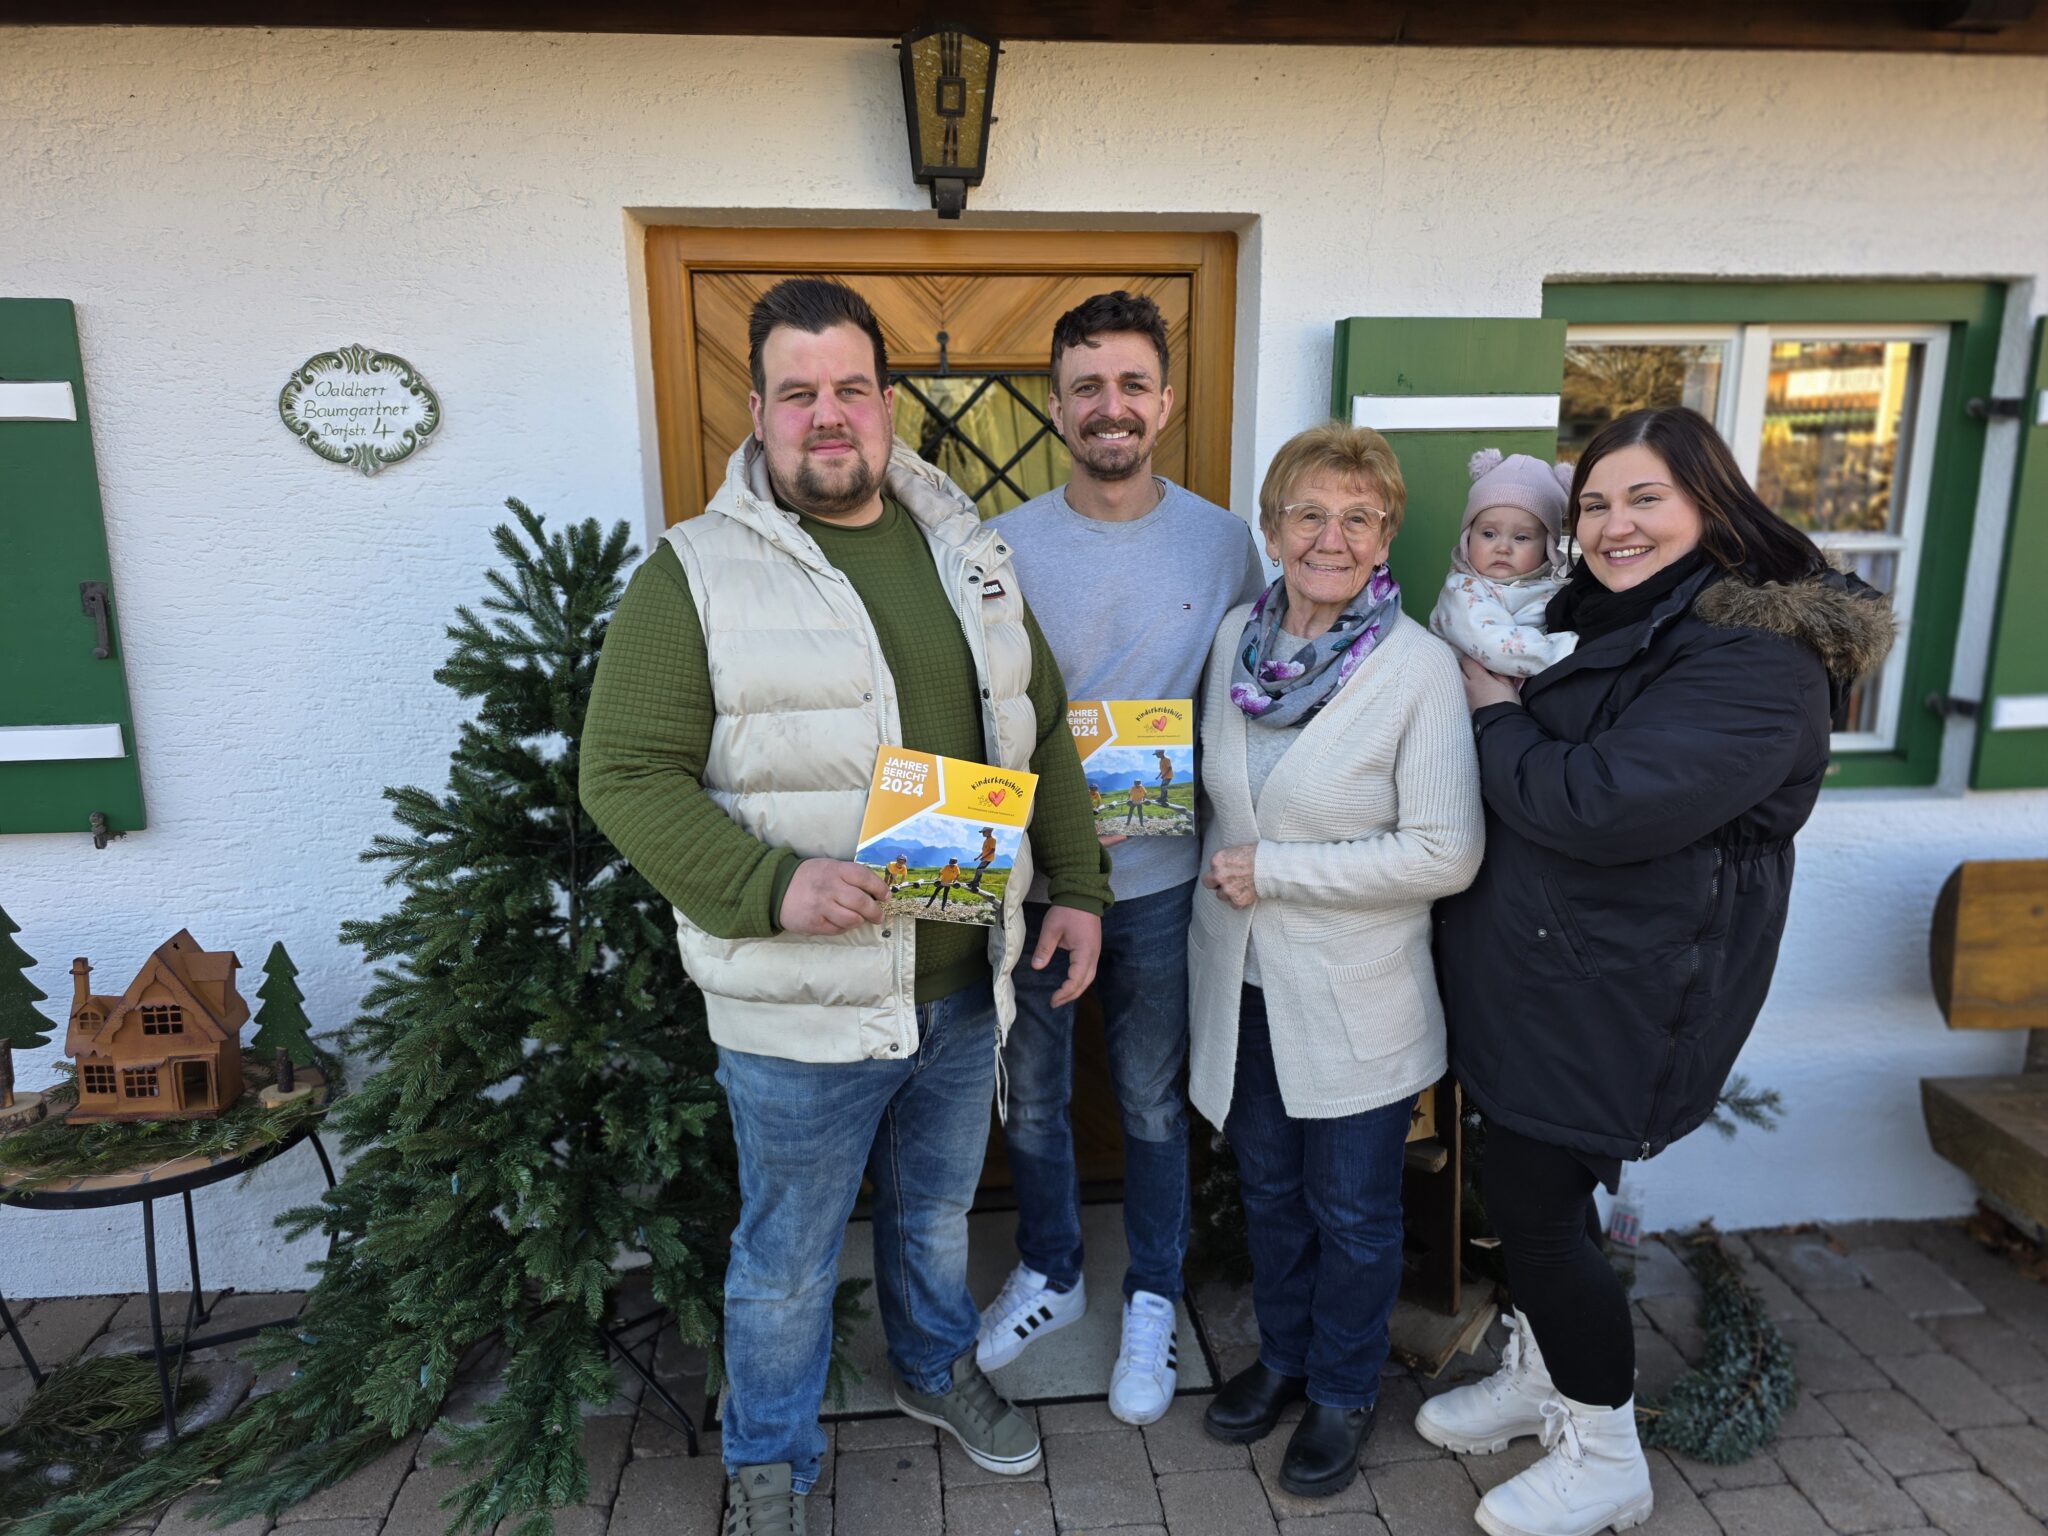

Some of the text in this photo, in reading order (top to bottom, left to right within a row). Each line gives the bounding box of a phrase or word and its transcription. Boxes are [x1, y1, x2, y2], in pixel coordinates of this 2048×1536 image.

[314, 381, 388, 397] Waldherr
[303, 399, 409, 422] Baumgartner
[321, 417, 395, 443] Dorfstr. 4
[1066, 717, 1098, 725] ERICHT
[1070, 725, 1098, 737] 024
[885, 756, 929, 773] JAHRES
[882, 766, 928, 783] BERICHT
[879, 776, 924, 798] 2024
